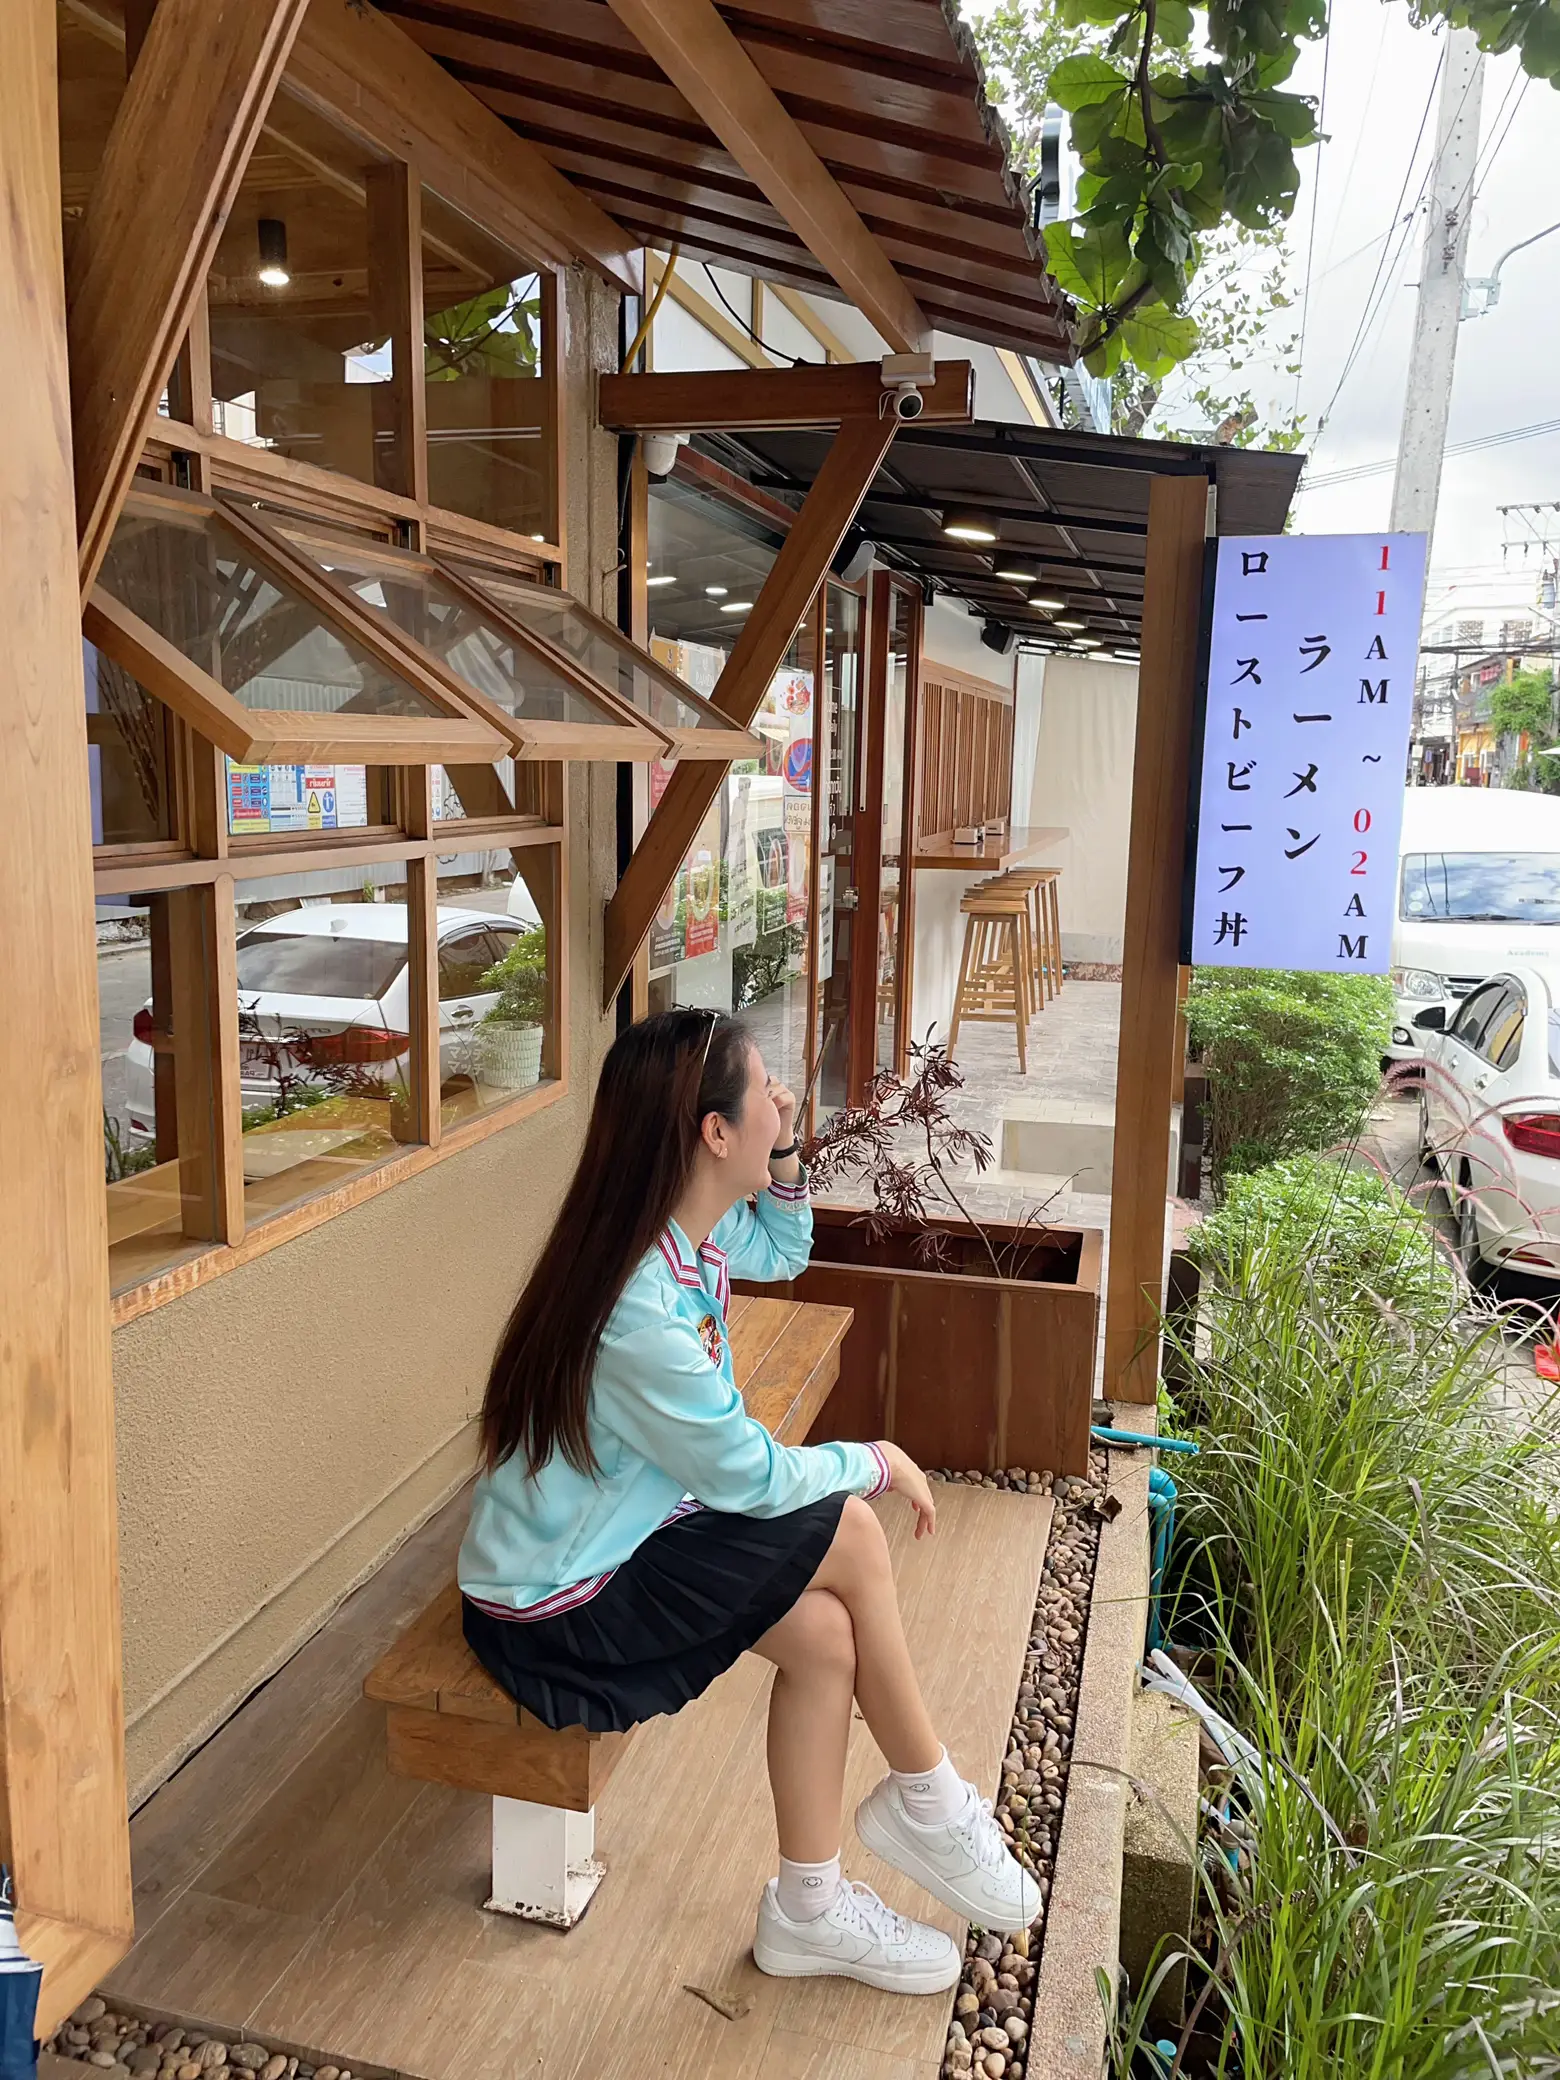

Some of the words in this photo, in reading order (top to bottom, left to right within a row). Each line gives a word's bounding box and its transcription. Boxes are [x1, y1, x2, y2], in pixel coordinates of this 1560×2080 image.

[1212, 550, 1270, 948] ローストビーフ丼
[1283, 634, 1333, 860] ラーメン
